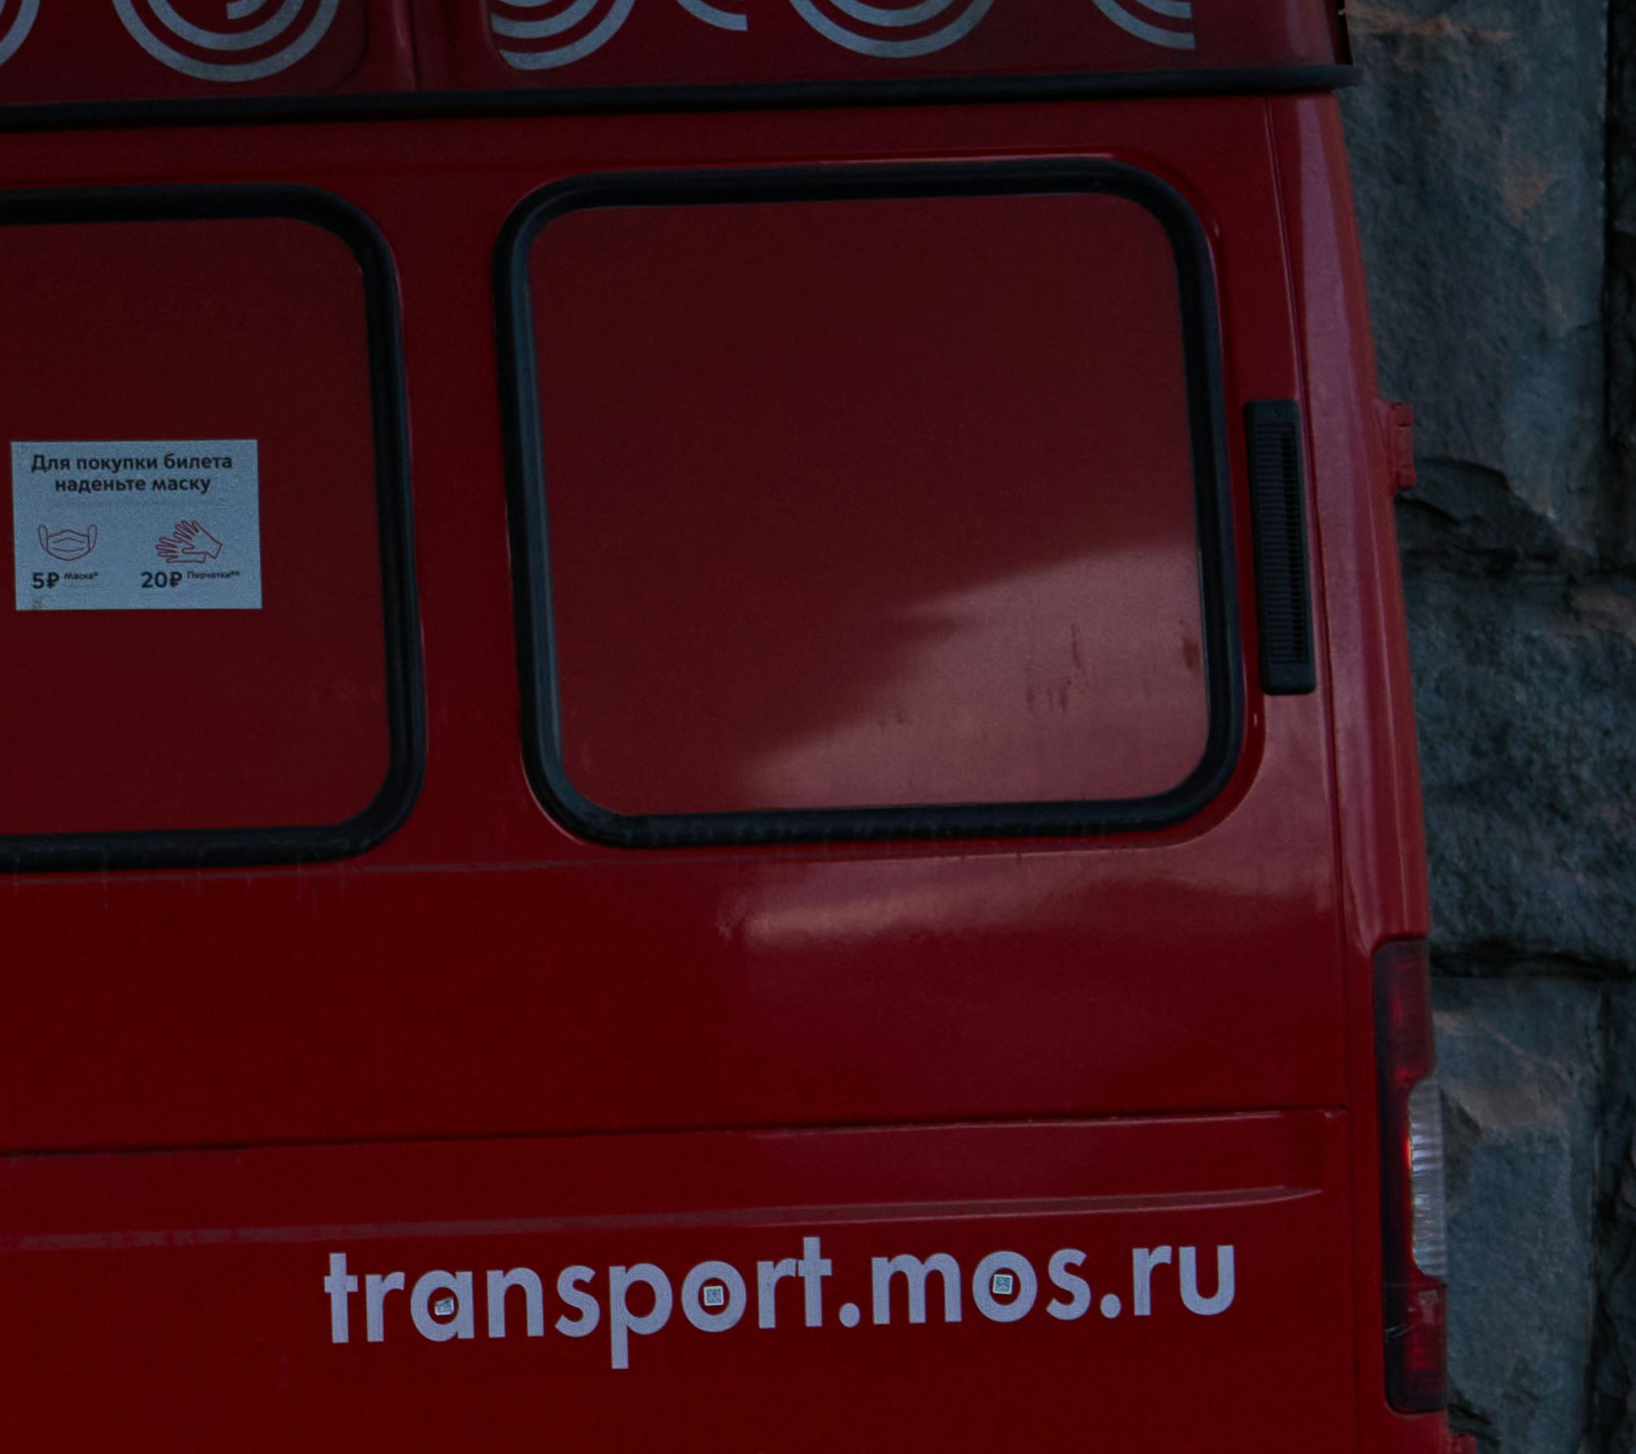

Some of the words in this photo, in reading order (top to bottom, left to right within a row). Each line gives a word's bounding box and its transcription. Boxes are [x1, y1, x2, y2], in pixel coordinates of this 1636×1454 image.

[31, 454, 71, 473] Для
[76, 456, 158, 474] покупки
[163, 452, 233, 470] билета
[55, 478, 146, 495] наденьте
[151, 478, 211, 495] маску
[323, 1236, 1236, 1370] transport.mos.ru
